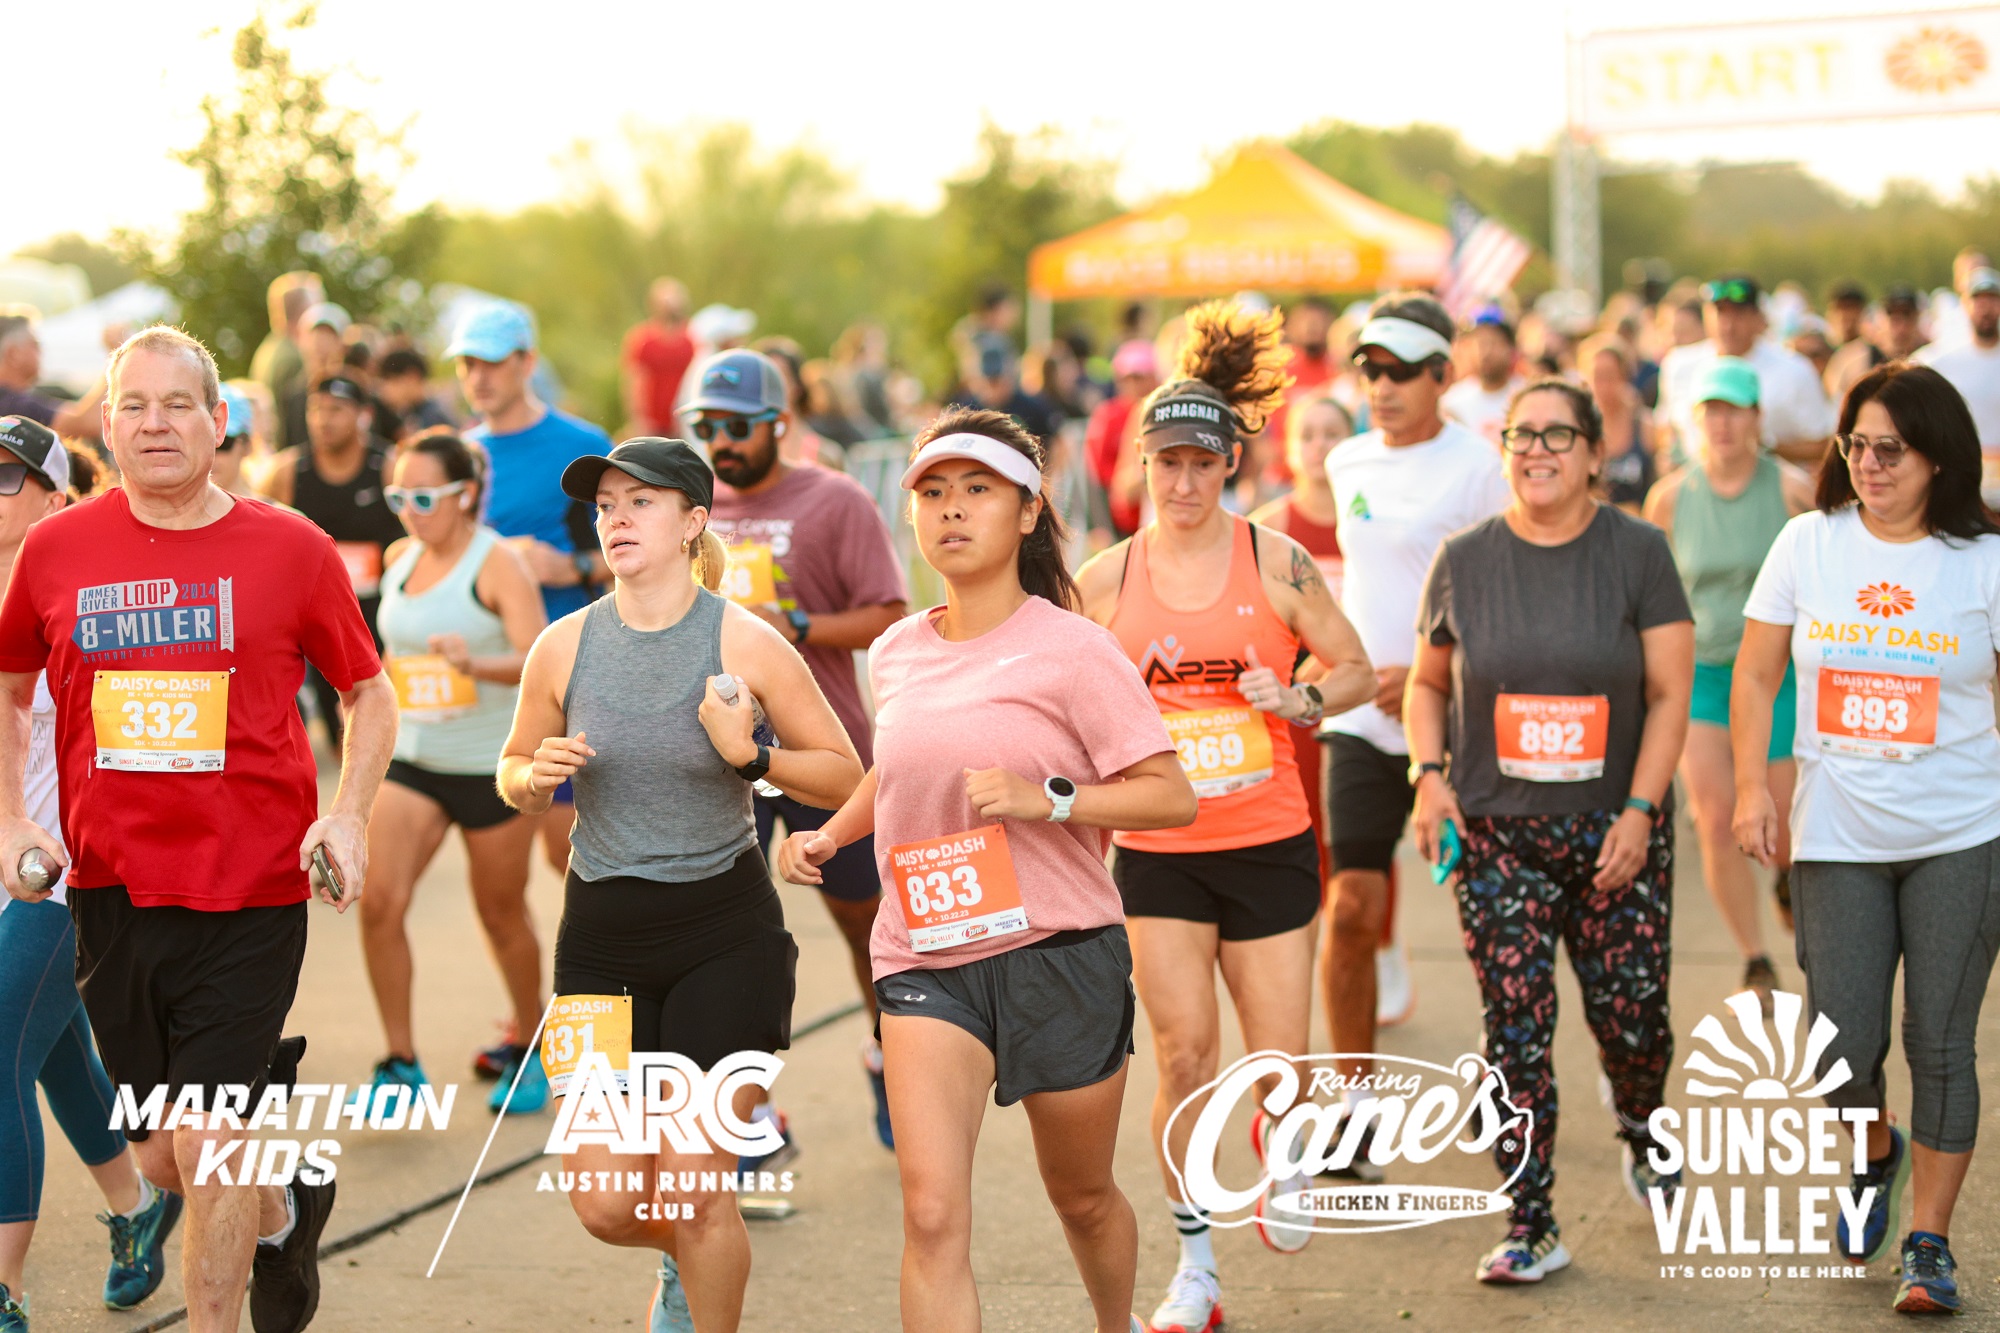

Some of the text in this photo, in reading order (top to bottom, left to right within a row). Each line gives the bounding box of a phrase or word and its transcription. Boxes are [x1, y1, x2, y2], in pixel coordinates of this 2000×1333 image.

[1600, 40, 1845, 108] START
[1171, 403, 1220, 423] RAGNAR
[81, 586, 117, 601] JAMES
[124, 582, 216, 607] LOOP 2014
[81, 597, 118, 613] RIVER
[81, 608, 212, 649] 8-MILER
[1808, 620, 1959, 656] DAISY DASH
[163, 643, 217, 656] FESTIVAL
[1885, 650, 1907, 660] KIDS
[1911, 653, 1935, 665] MILE
[110, 677, 211, 691] DAISY DASH
[1833, 674, 1872, 688] DAISY
[1885, 678, 1922, 693] DASH
[1509, 699, 1596, 715] DAISY DASH
[1841, 694, 1908, 733] 893
[121, 700, 198, 738] 332
[1164, 712, 1250, 731] DAISY DASH
[1519, 720, 1584, 754] 892
[1177, 733, 1244, 771] 369
[895, 836, 986, 867] DAISY DASH
[937, 859, 952, 867] KIDS
[953, 856, 968, 864] MILE
[906, 865, 982, 916] 833
[940, 910, 969, 921] 10.22.23
[938, 934, 954, 942] VALLEY
[571, 1001, 613, 1014] DASH
[546, 1023, 594, 1066] 331
